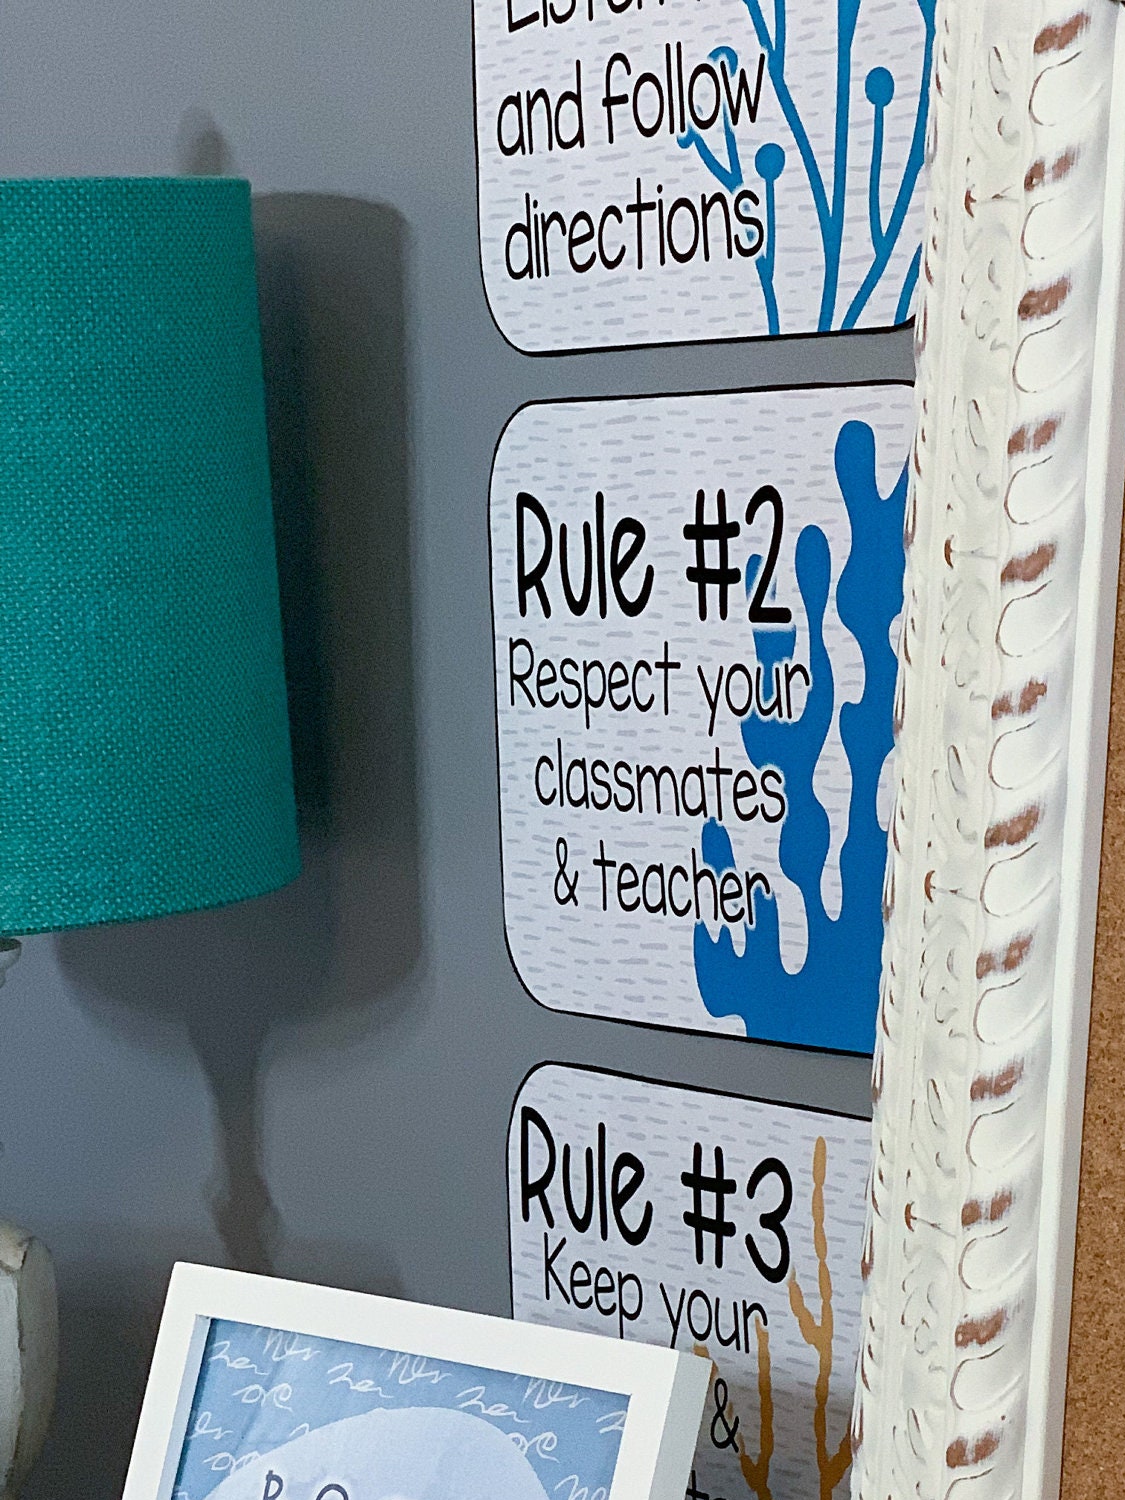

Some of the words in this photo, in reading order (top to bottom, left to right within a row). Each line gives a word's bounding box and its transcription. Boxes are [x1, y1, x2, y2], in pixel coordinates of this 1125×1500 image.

[497, 59, 585, 157] and
[601, 41, 767, 145] follow
[505, 177, 765, 281] directions
[516, 490, 655, 620] Rule
[682, 484, 793, 624] #2
[508, 637, 682, 730] Respect
[696, 663, 811, 737] your
[534, 737, 786, 823] classmates
[553, 836, 579, 907] &
[592, 839, 771, 926] teacher
[520, 1105, 654, 1248] Rule
[680, 1142, 793, 1284] #3
[543, 1231, 643, 1340] Keep
[659, 1282, 768, 1354] your
[709, 1377, 740, 1455] &
